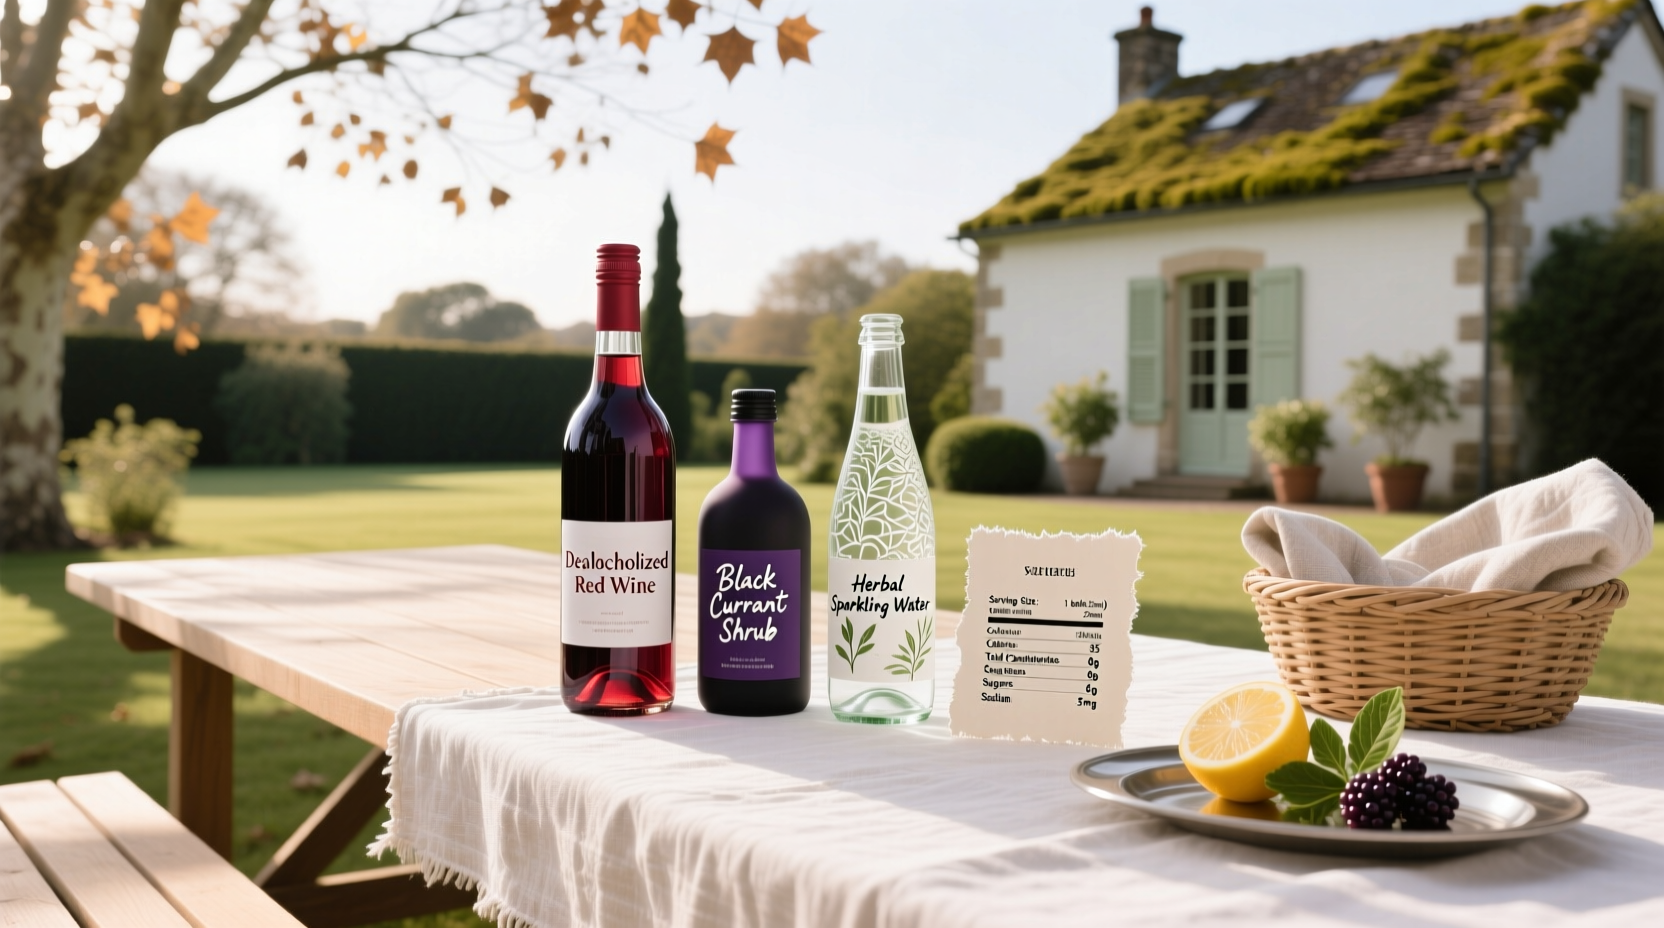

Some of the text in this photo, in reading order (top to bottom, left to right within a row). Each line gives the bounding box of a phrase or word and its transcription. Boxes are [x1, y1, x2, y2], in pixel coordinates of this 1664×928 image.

[565, 550, 668, 570] Dealocholized
[575, 576, 656, 594] Red Wine
[716, 563, 777, 592] Black
[851, 574, 904, 592] Herbal
[710, 590, 788, 618] Currant
[831, 594, 930, 619] Sparkling Water
[719, 616, 778, 643] Shrub
